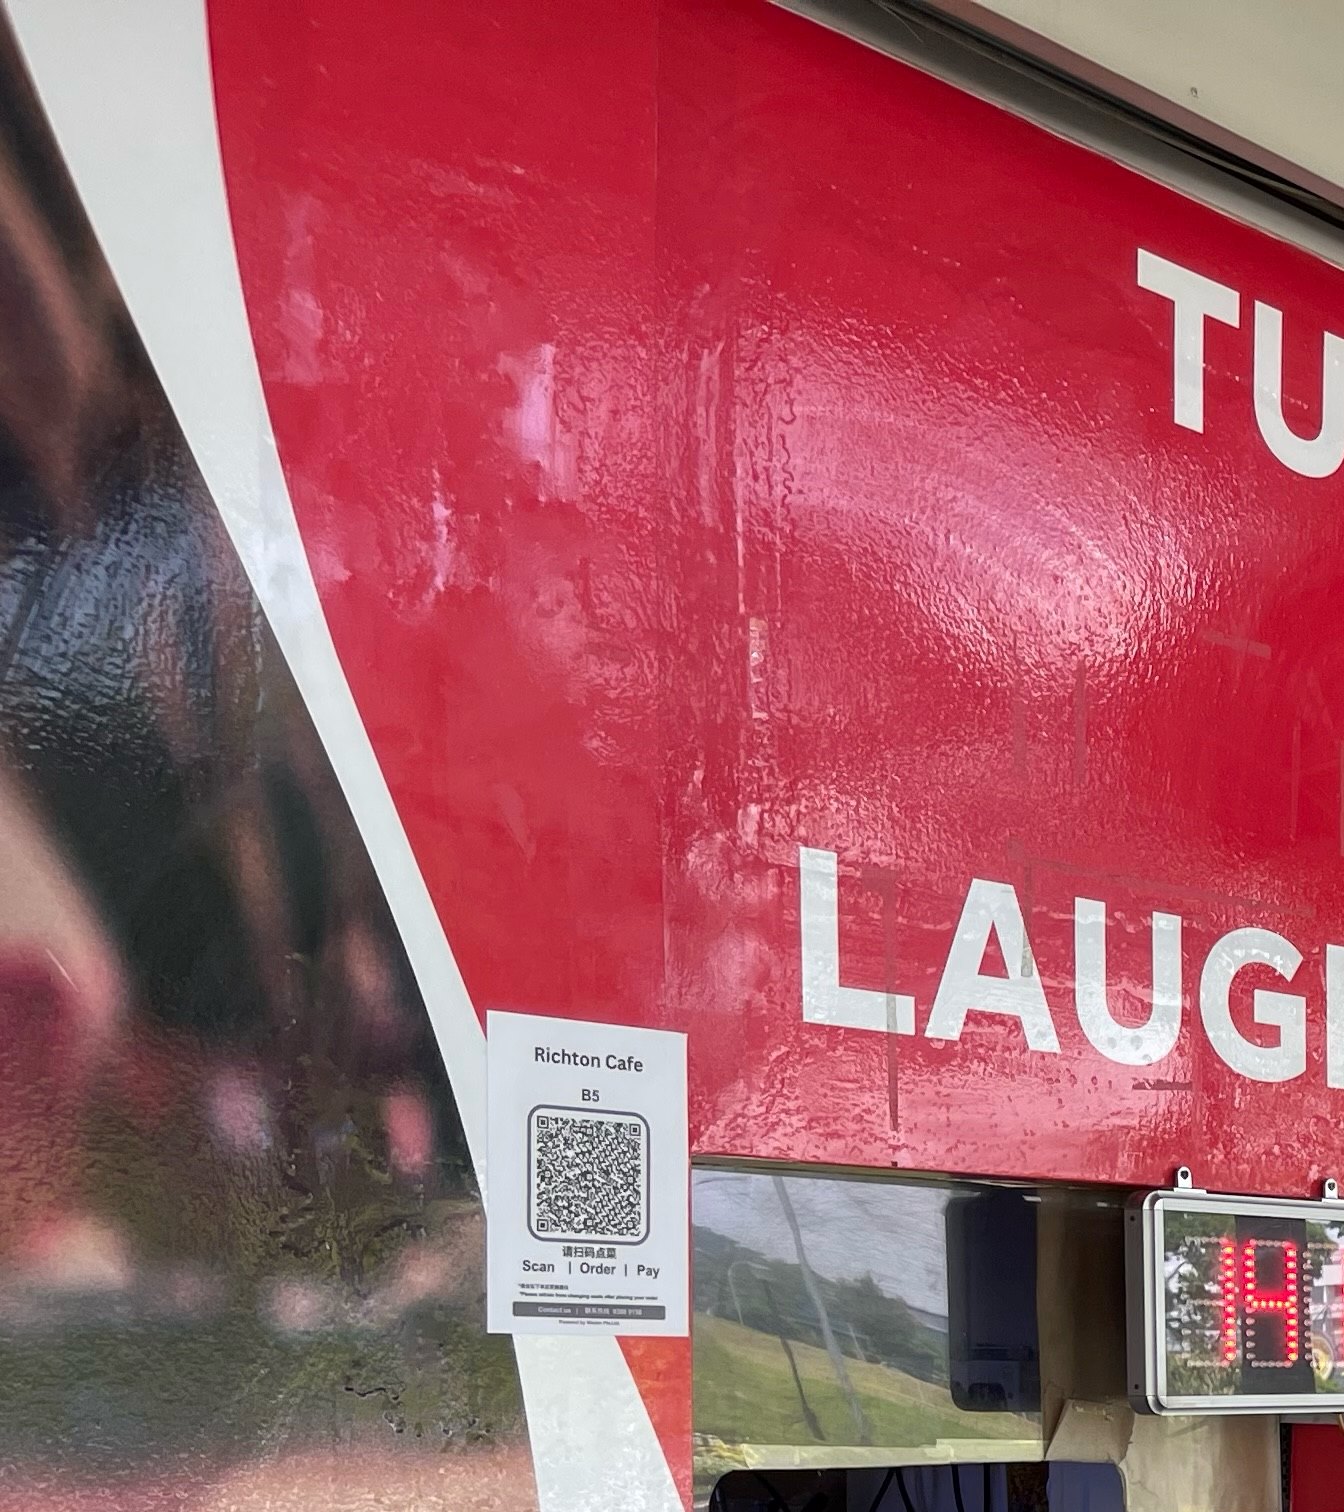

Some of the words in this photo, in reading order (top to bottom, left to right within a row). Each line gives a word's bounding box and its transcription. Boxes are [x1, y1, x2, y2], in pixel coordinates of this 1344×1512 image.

[534, 1047, 601, 1069] Richton
[605, 1054, 644, 1073] Cafe
[581, 1089, 600, 1102] B5
[562, 1245, 617, 1259] 请扫码点菜
[522, 1260, 555, 1273] Scan
[580, 1262, 616, 1275] Order
[637, 1264, 660, 1279] Pay
